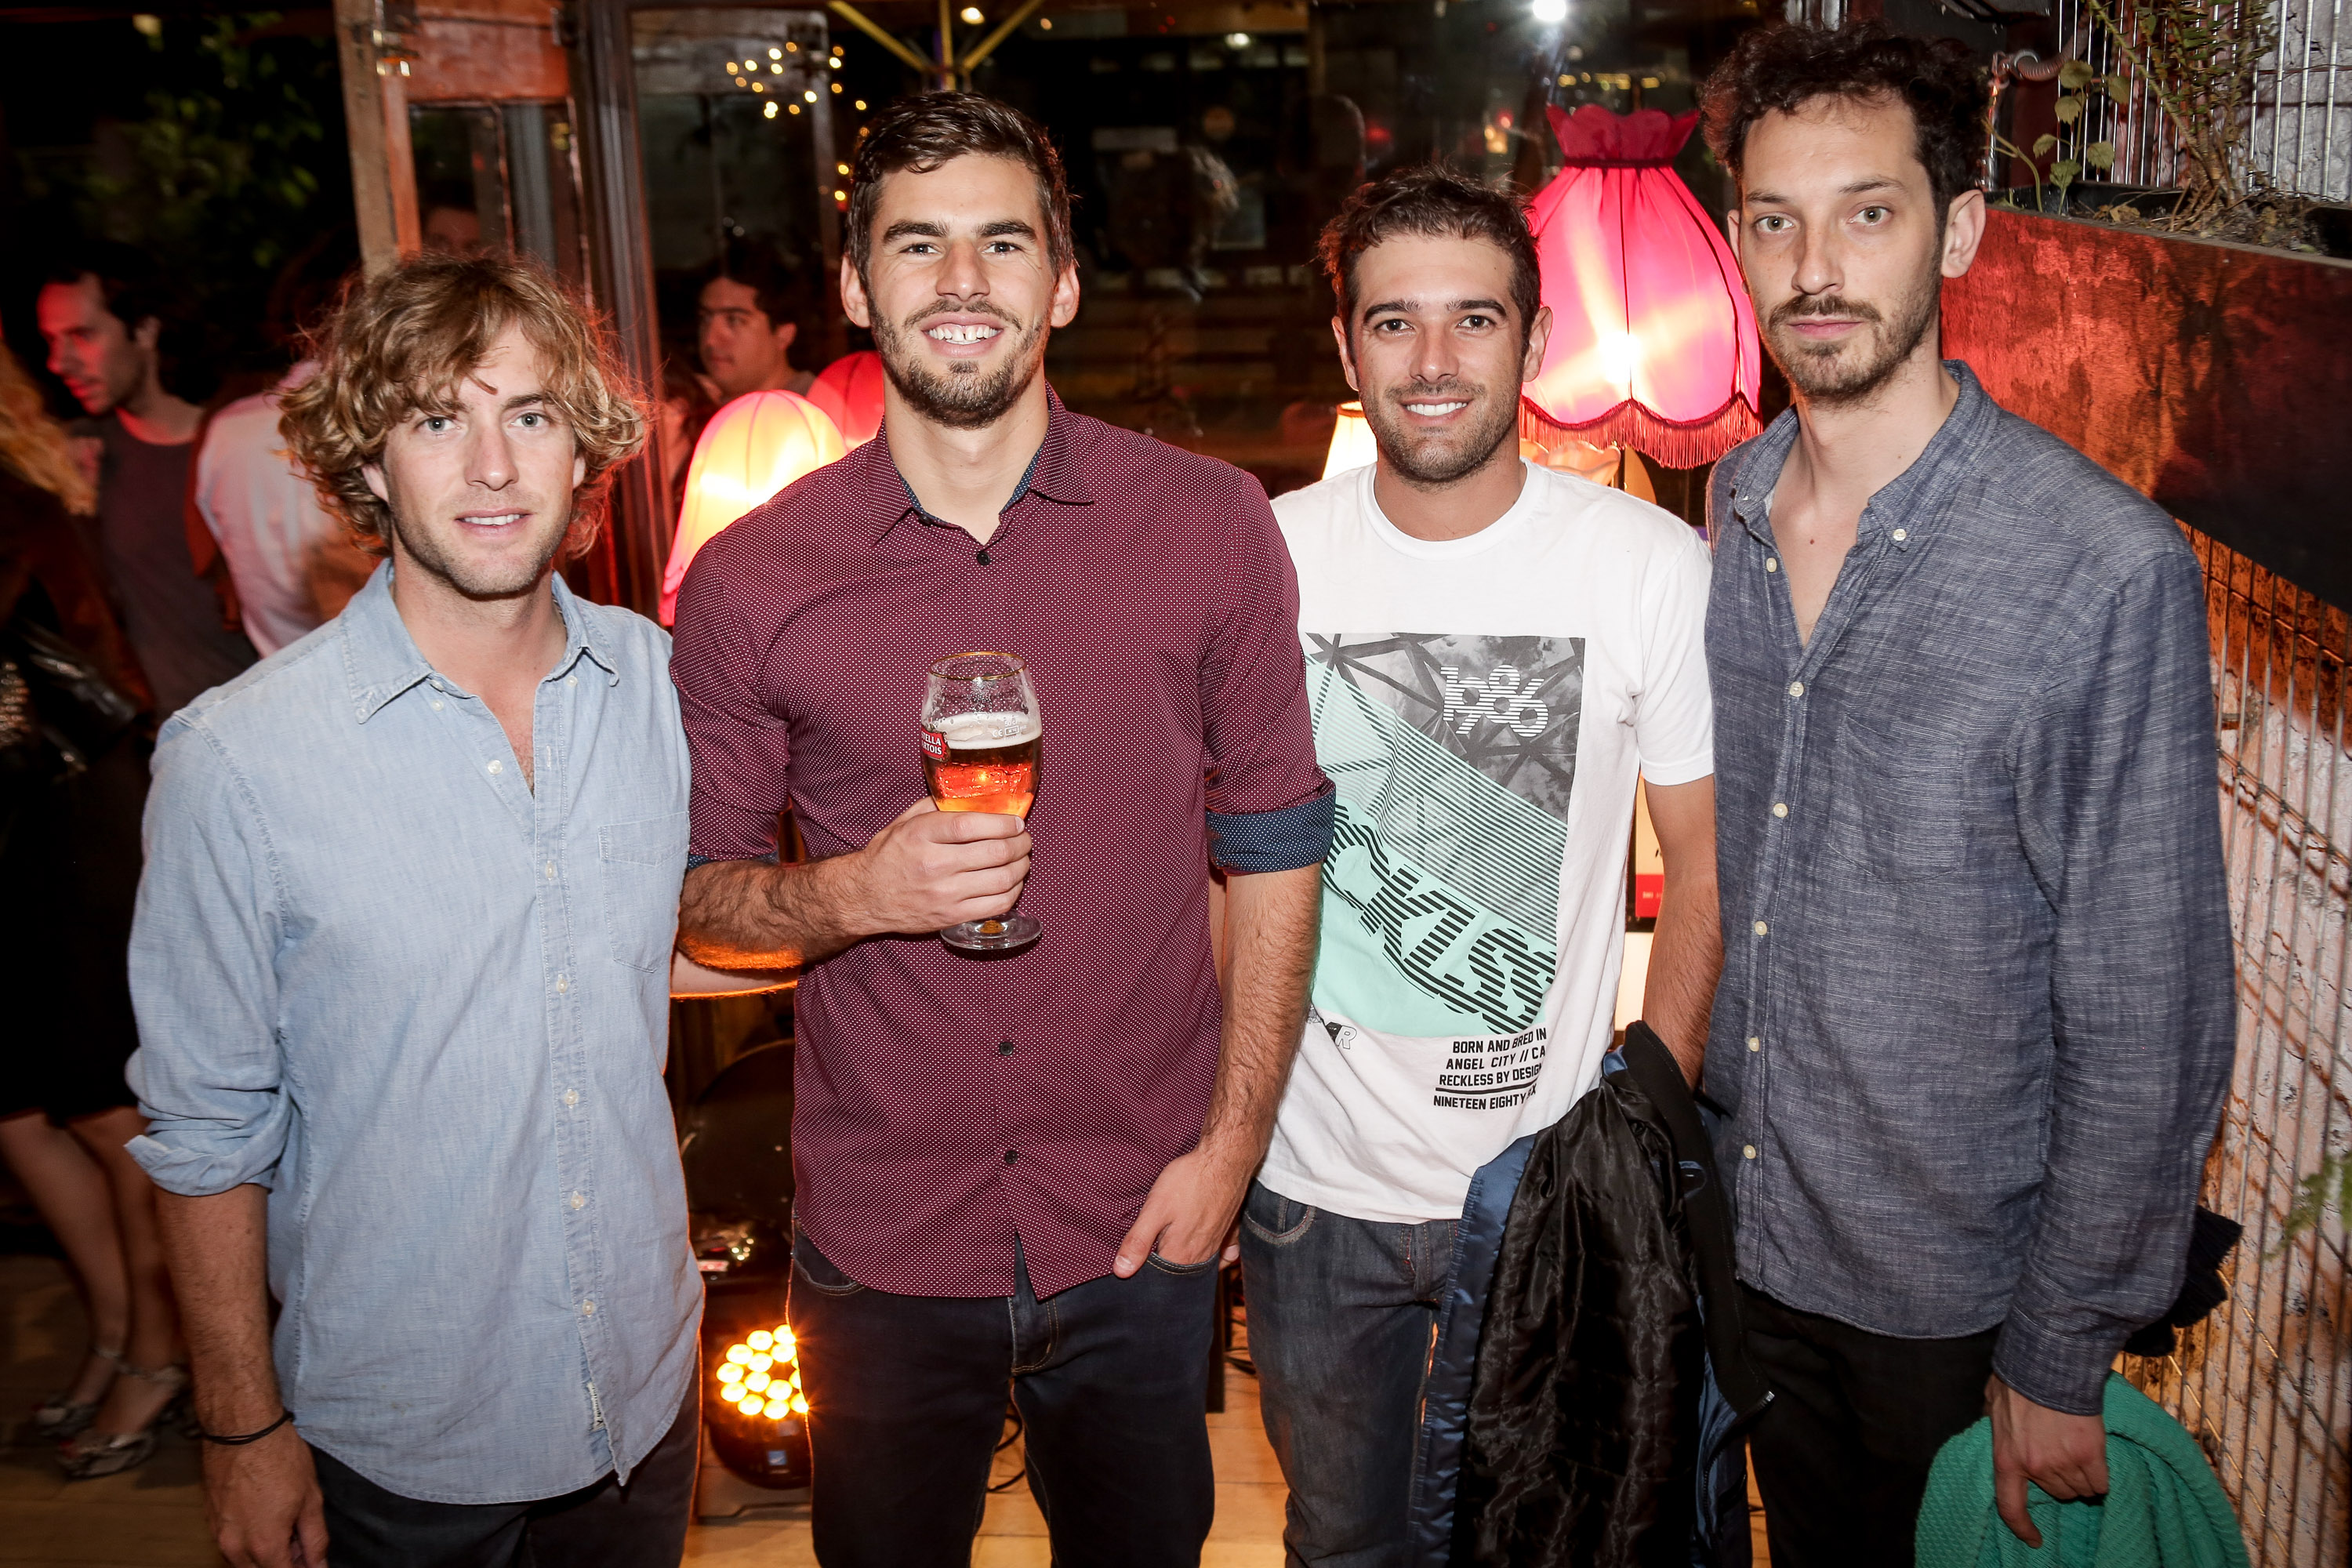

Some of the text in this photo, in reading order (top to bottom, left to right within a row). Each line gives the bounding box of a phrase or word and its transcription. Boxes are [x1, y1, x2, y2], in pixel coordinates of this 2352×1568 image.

[922, 740, 942, 755] RTOIS
[1453, 1028, 1547, 1054] BORN AND BRED IN
[1446, 1058, 1485, 1070] ANGEL
[1490, 1053, 1516, 1068] CITY
[1532, 1045, 1546, 1059] CA
[1439, 1073, 1494, 1087] RECKLESS
[1497, 1071, 1510, 1083] BY
[1433, 1095, 1486, 1110] NINETEEN
[1490, 1093, 1526, 1109] EIGHTY
